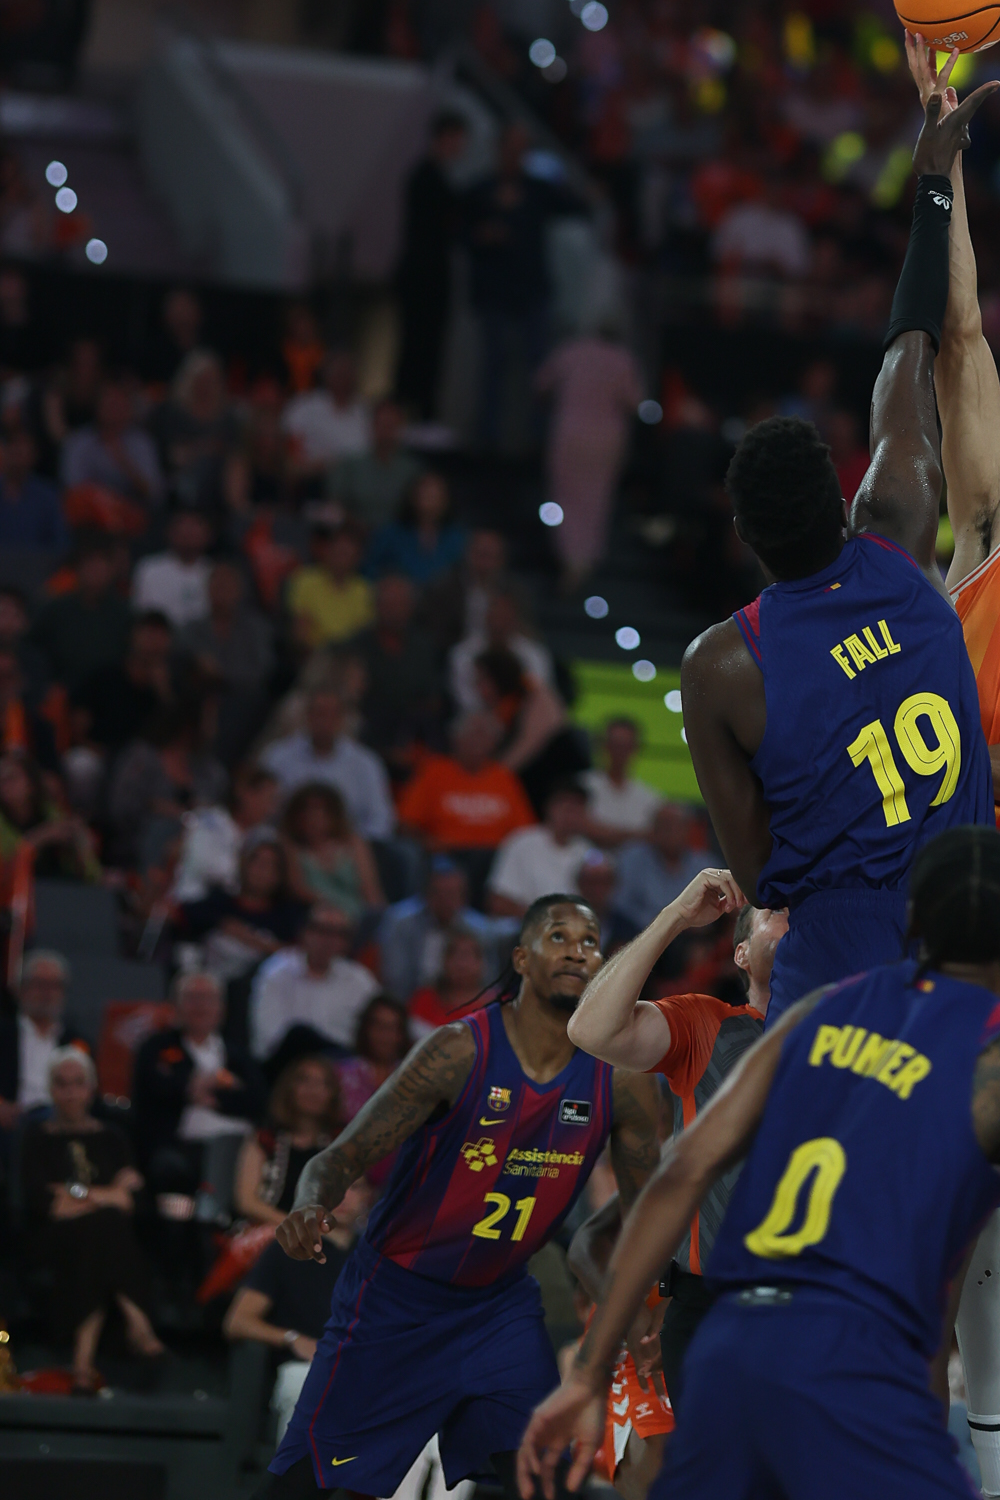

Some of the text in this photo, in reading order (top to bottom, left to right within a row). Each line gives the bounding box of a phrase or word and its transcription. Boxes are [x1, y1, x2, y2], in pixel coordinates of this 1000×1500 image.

[829, 619, 901, 680] FALL
[846, 692, 961, 828] 19
[471, 1192, 537, 1241] 21
[744, 1136, 847, 1259] 0
